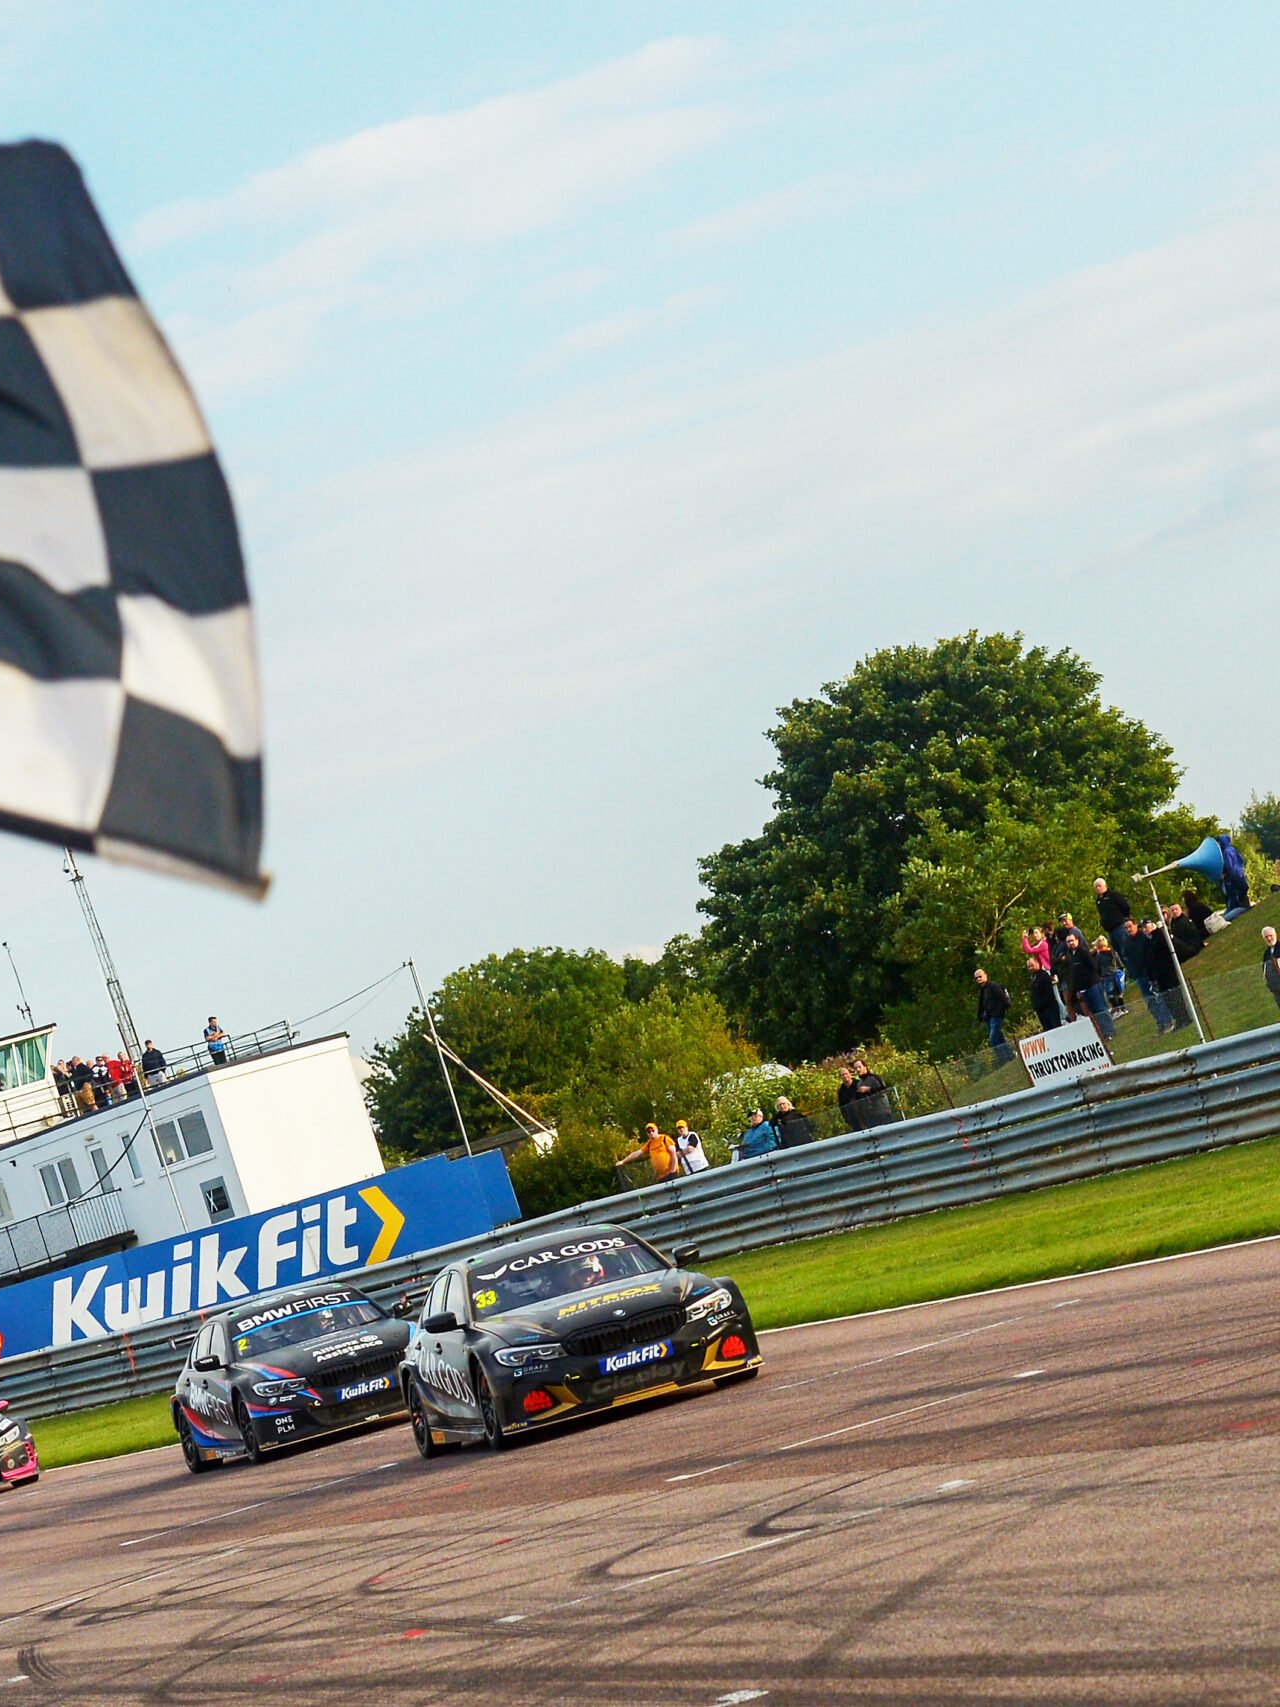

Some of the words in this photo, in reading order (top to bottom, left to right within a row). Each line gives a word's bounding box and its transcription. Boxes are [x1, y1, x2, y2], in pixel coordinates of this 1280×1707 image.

[1021, 1037, 1050, 1059] WWW.
[1028, 1041, 1105, 1080] THRUXTONRACING
[509, 1249, 561, 1271] CAR
[560, 1236, 626, 1257] GODS
[475, 1290, 497, 1309] 33
[557, 1282, 662, 1317] NITROX
[237, 1338, 248, 1351] 2
[312, 1339, 360, 1357] Allianz
[316, 1339, 384, 1363] Assistance
[275, 1415, 294, 1426] ONE
[277, 1423, 296, 1434] PLM
